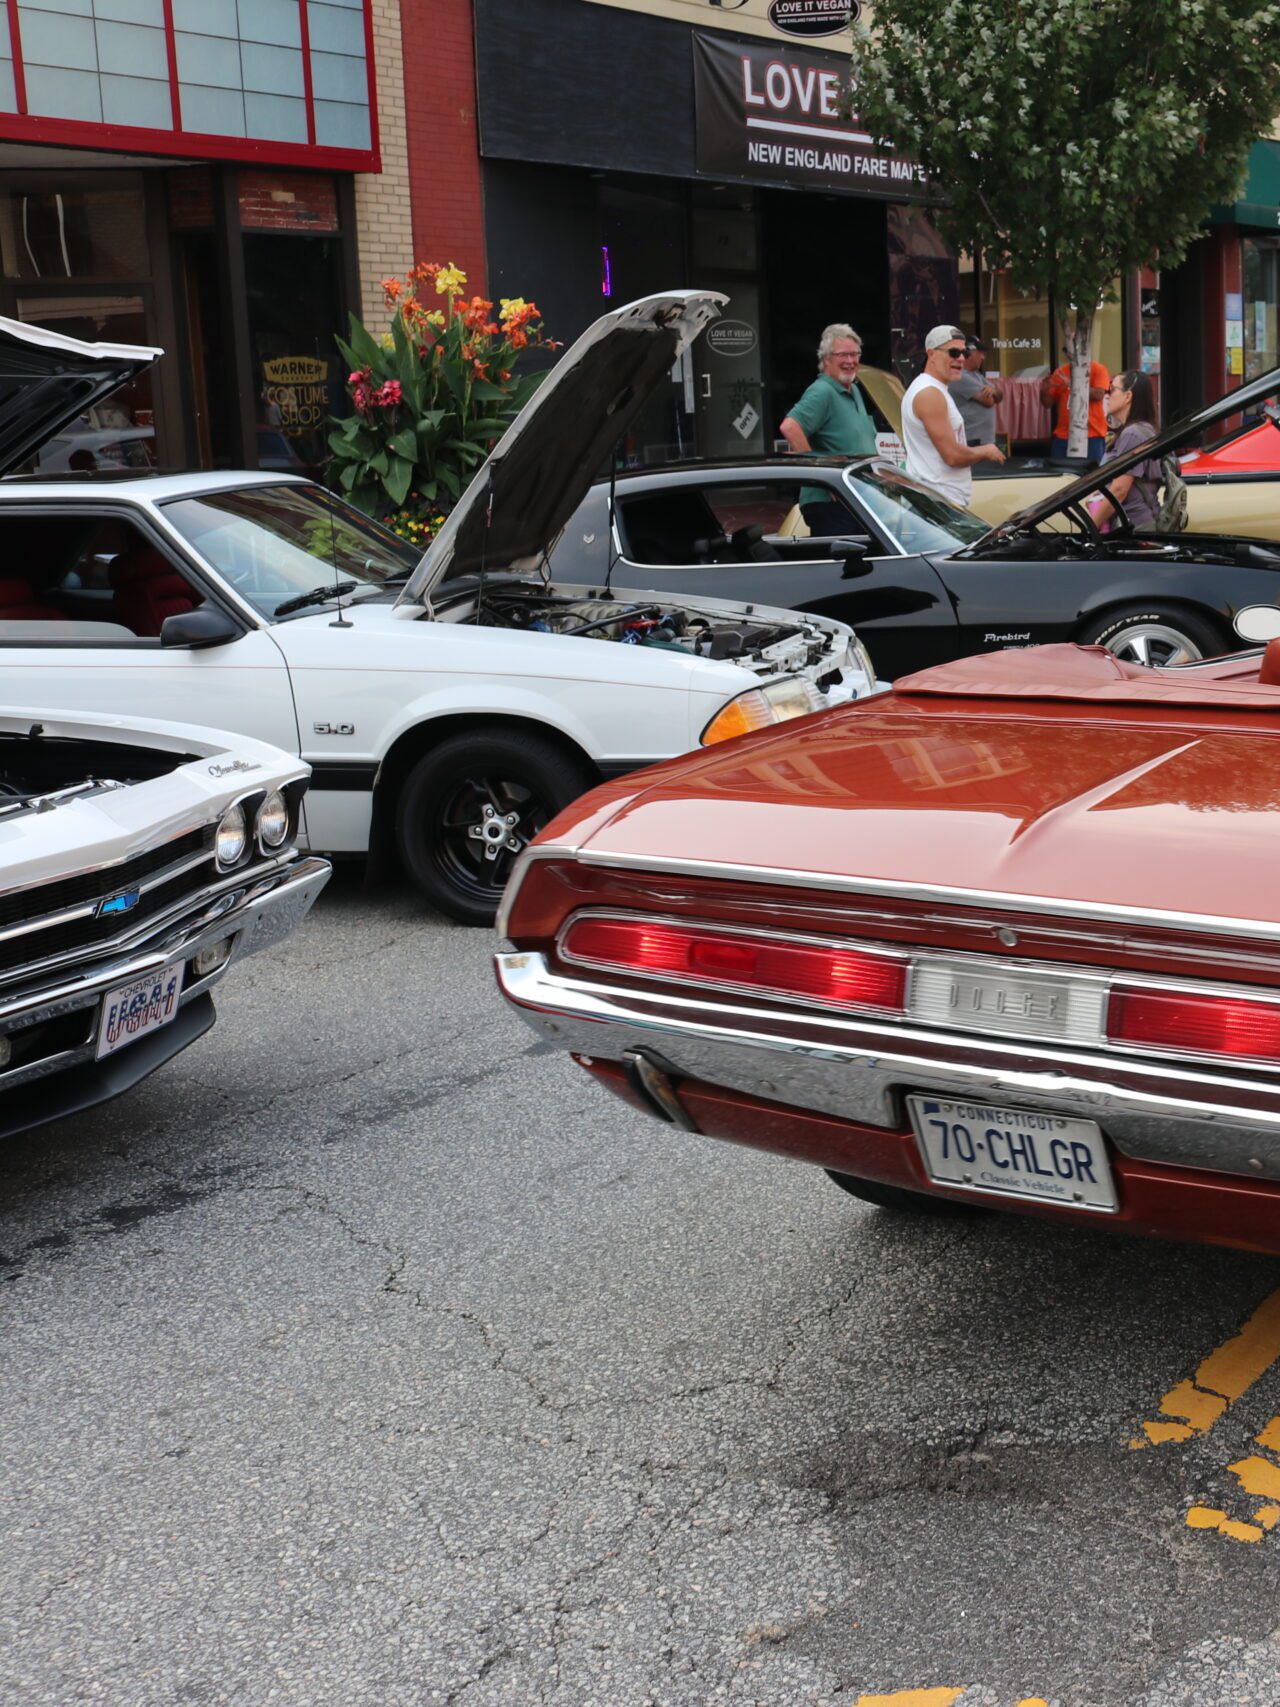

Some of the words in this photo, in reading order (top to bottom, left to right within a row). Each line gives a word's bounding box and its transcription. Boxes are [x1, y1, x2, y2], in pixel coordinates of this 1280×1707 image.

[775, 1, 802, 13] LOVE
[804, 1, 814, 11] IT
[816, 0, 852, 10] VEGAN
[742, 57, 839, 118] LOVE
[748, 142, 782, 165] NEW
[785, 147, 851, 173] ENGLAND
[854, 156, 888, 178] FARE
[992, 338, 1012, 348] Tina's
[1013, 338, 1030, 348] Cafe
[270, 362, 322, 376] WARNER
[267, 386, 329, 405] COSTUME
[281, 406, 321, 425] SHOP
[739, 411, 754, 431] OPEN
[983, 632, 1030, 642] Firebird
[313, 721, 355, 735] 5.0
[124, 970, 168, 998] CHEVROLET
[949, 983, 1058, 1020] DODGE
[956, 1105, 1054, 1131] CONNECTICUT
[980, 1171, 1020, 1188] Classic
[1024, 1178, 1065, 1195] Vehicle
